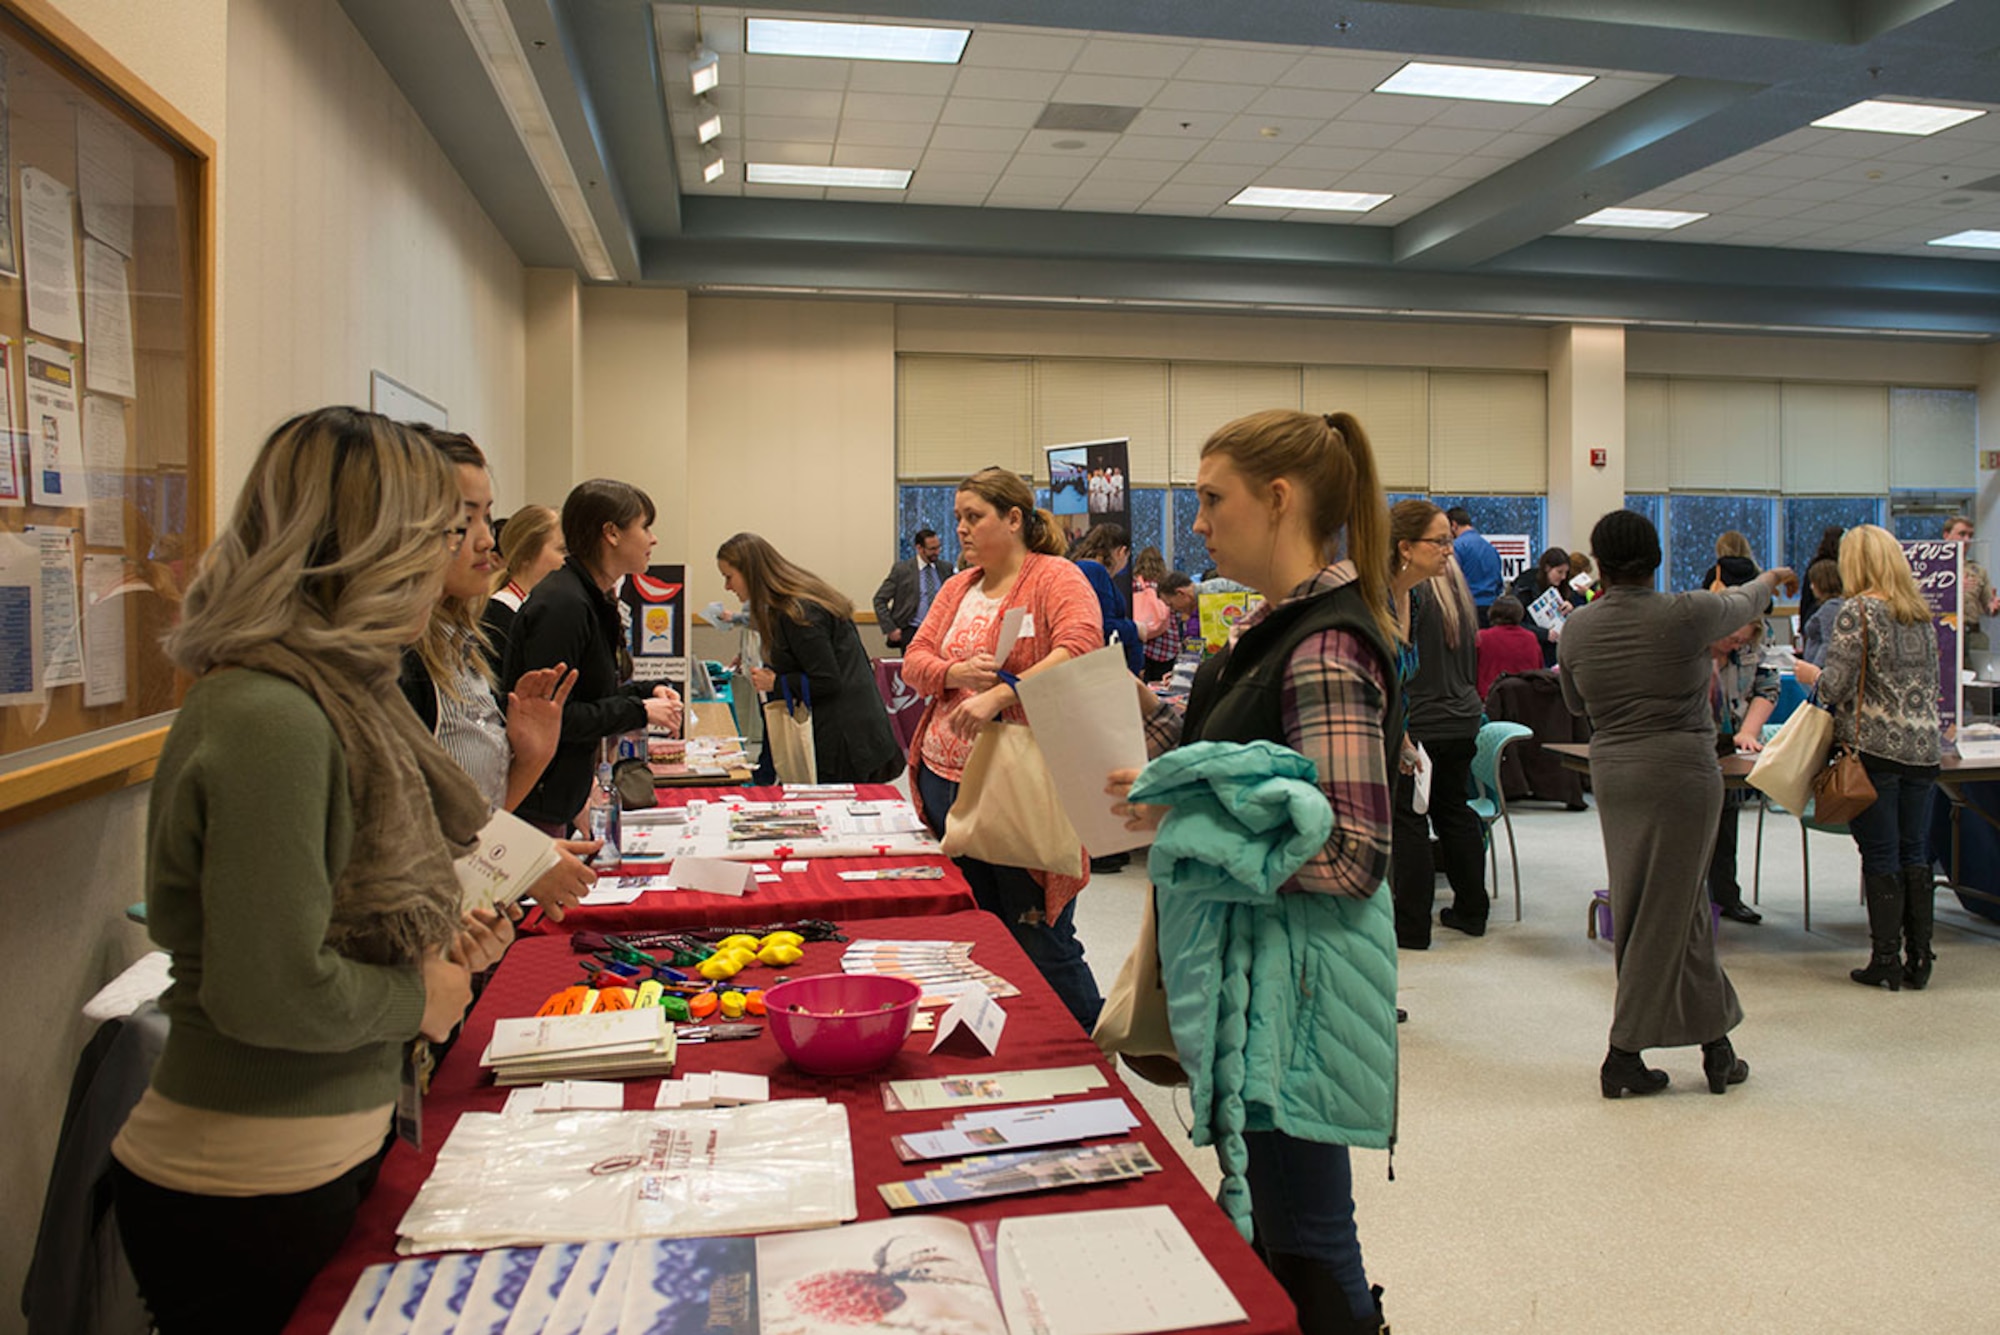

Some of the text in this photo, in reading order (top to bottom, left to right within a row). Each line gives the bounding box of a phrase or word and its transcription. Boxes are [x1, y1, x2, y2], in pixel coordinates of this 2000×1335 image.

[1900, 542, 1956, 560] AWS
[1503, 558, 1526, 576] NT
[1913, 561, 1928, 571] to
